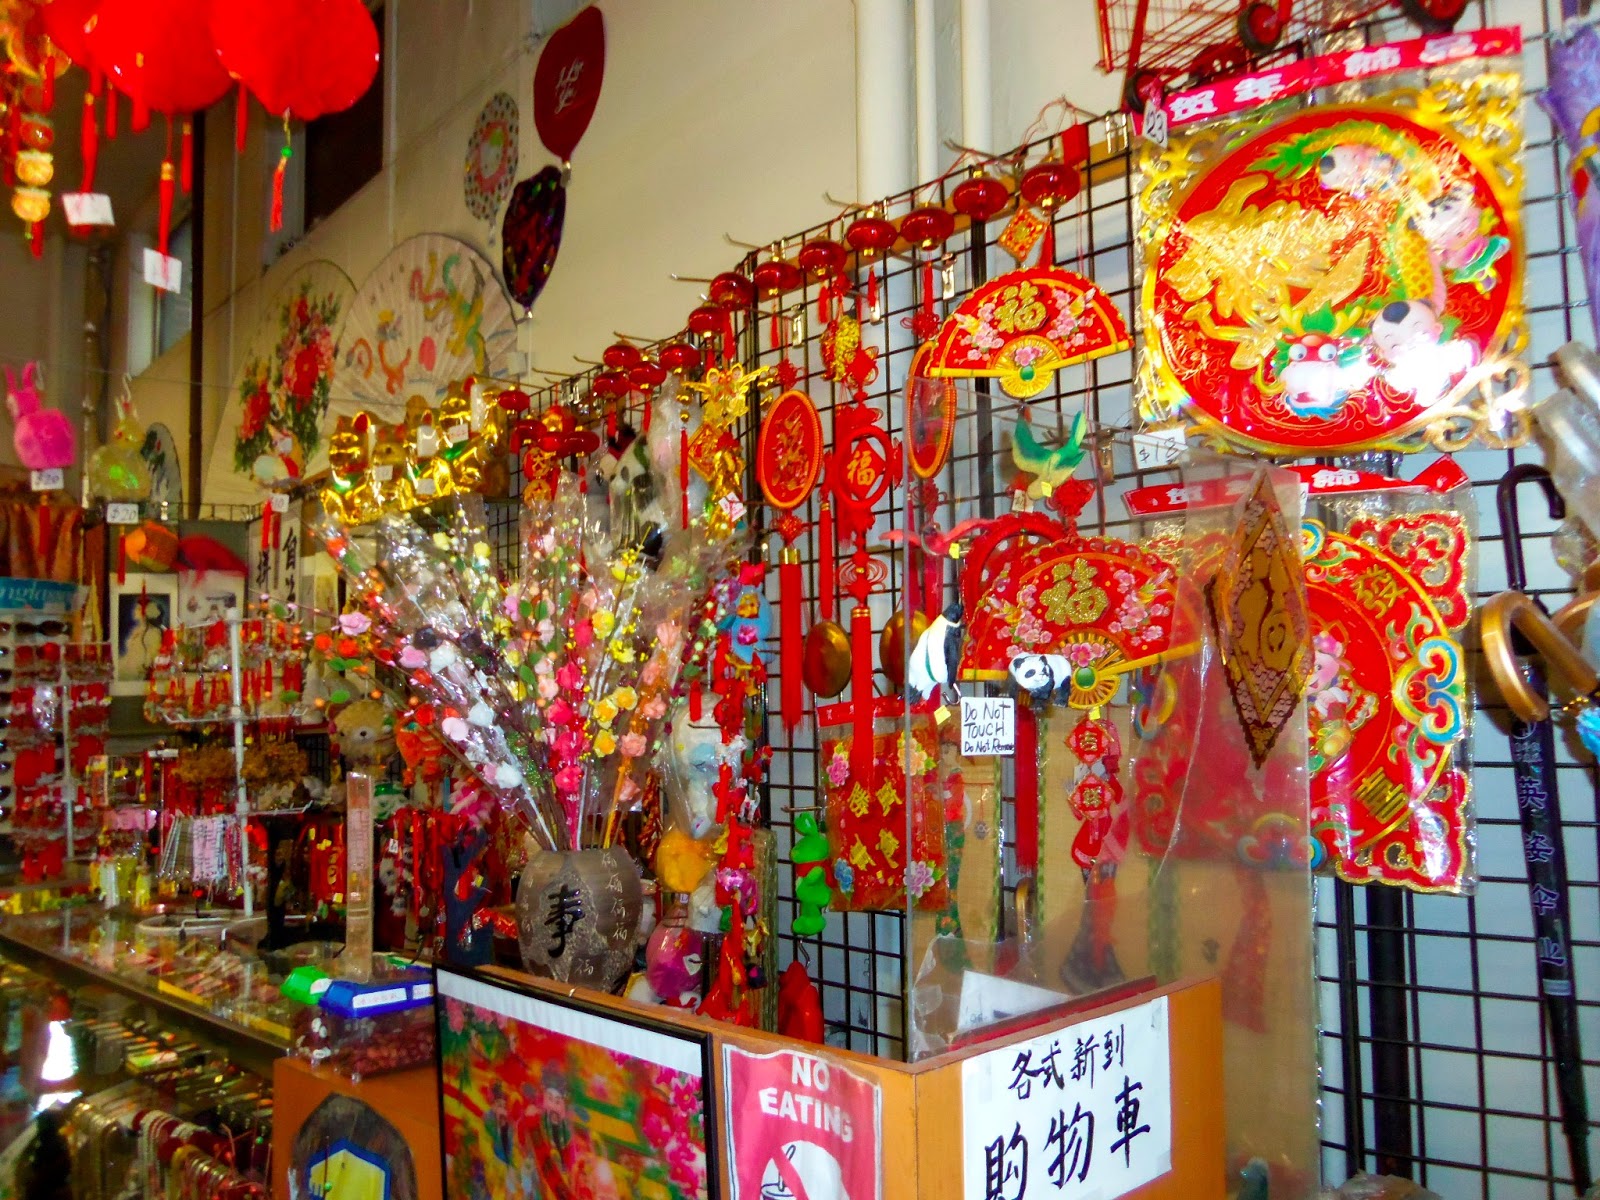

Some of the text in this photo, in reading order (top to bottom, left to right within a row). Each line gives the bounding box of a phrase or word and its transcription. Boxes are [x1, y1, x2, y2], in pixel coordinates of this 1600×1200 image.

[995, 281, 1047, 333] 福
[847, 451, 876, 486] 福
[1040, 557, 1108, 627] 福
[964, 722, 1005, 739] TOUCH
[791, 1055, 831, 1092] NO
[1008, 1023, 1125, 1100] 各式新到
[758, 1086, 854, 1143] EATING
